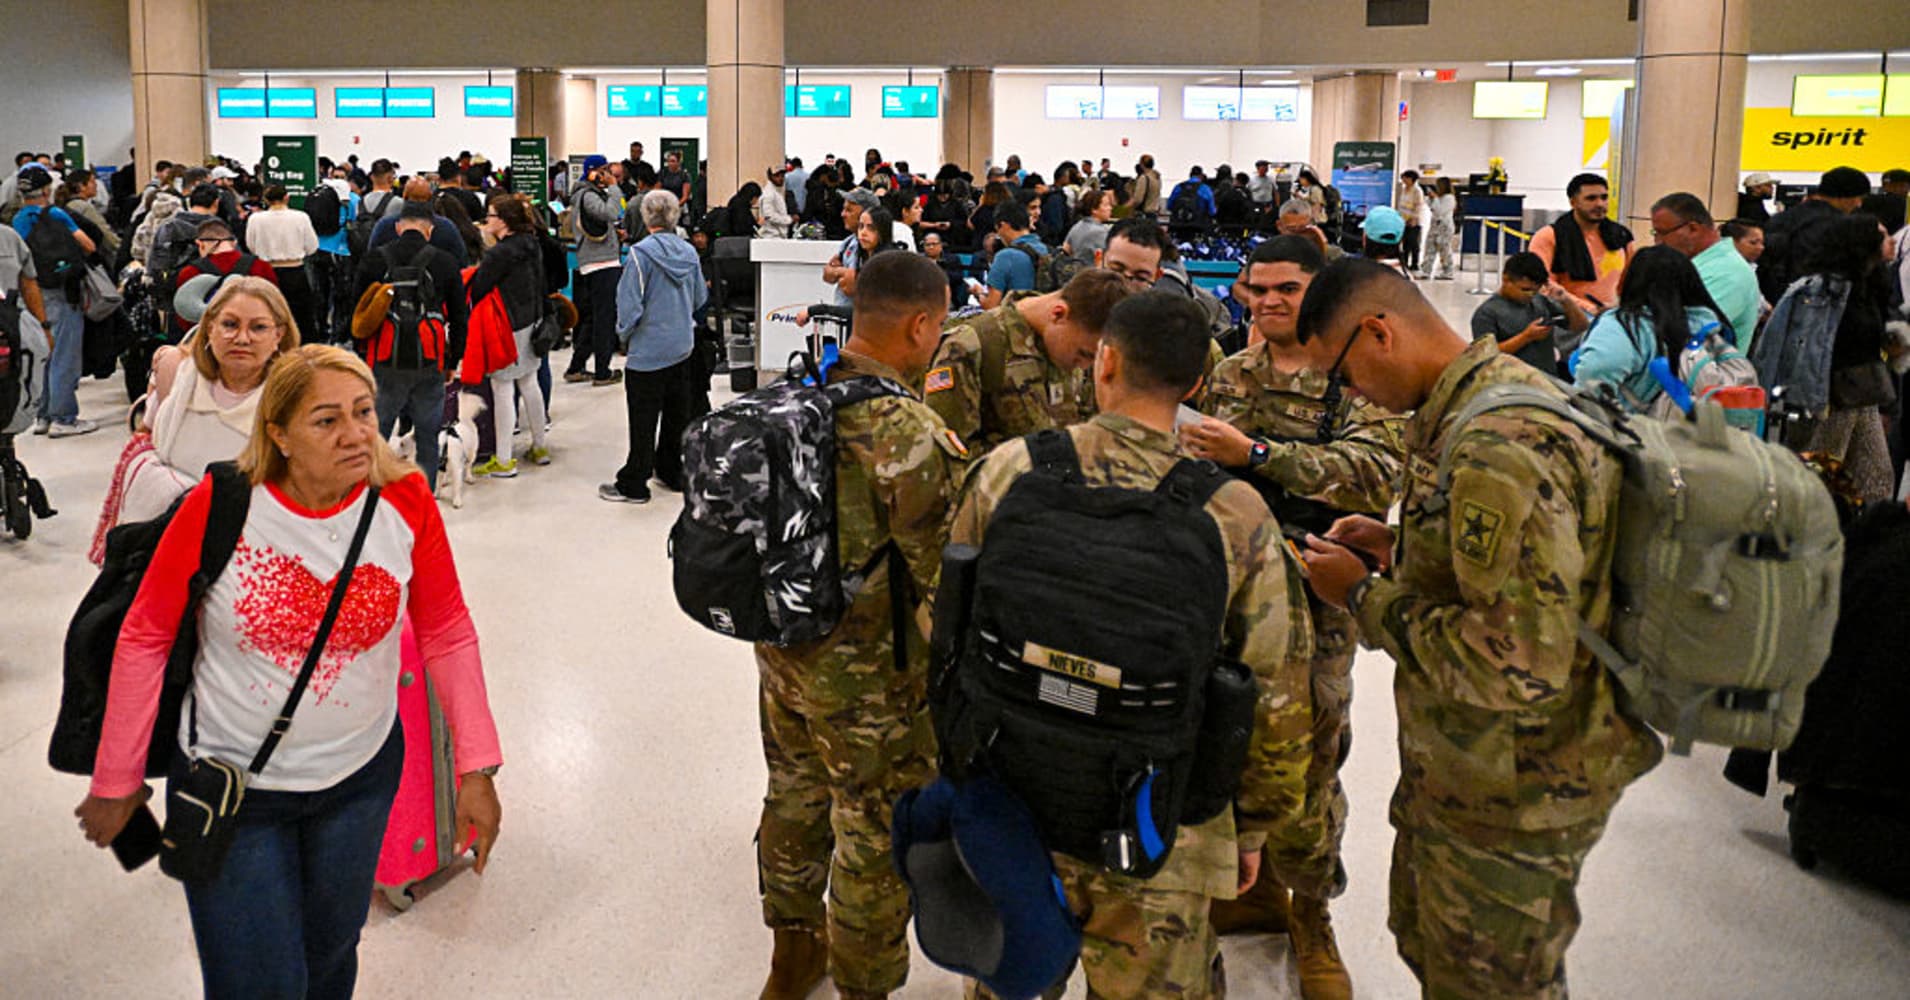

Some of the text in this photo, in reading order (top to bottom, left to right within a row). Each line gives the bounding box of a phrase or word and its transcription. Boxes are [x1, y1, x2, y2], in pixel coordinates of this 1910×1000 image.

[1771, 128, 1867, 150] spirit
[268, 171, 285, 180] Tag
[1049, 652, 1097, 678] NIEVES
